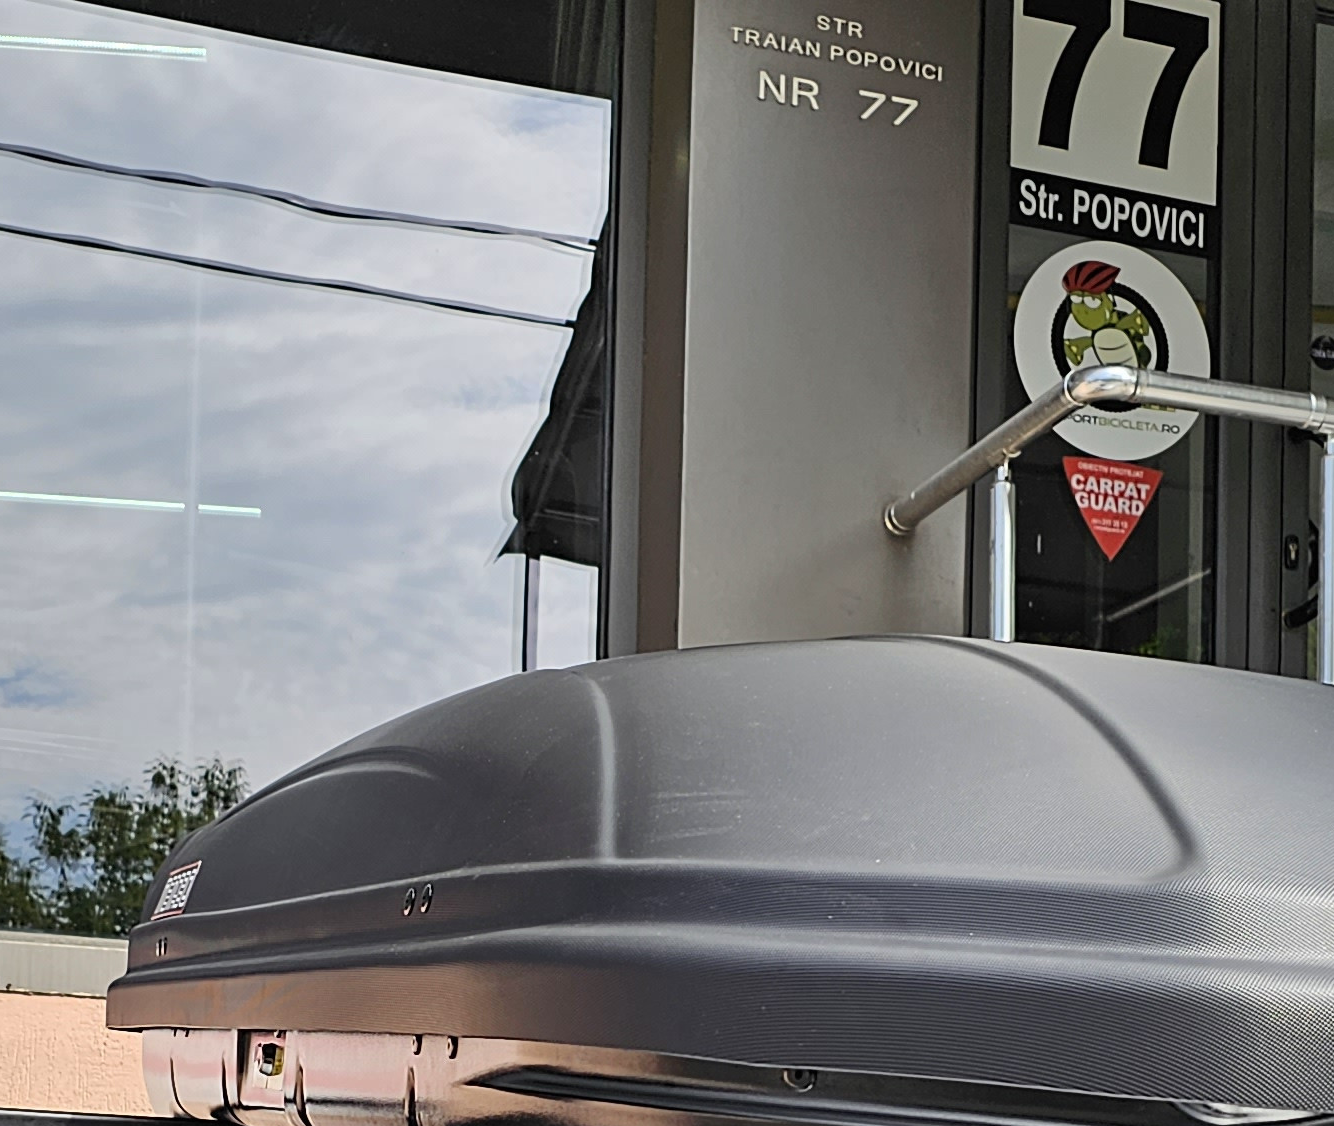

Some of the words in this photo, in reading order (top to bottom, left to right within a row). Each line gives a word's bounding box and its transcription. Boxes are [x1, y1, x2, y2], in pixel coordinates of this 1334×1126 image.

[731, 26, 821, 58] TRAIAN
[829, 44, 943, 82] POPOVICI
[816, 14, 864, 39] STR
[757, 70, 820, 110] NR
[858, 89, 919, 126] 77
[1023, 0, 1210, 170] 77
[1019, 178, 1064, 222] Str.
[1072, 188, 1205, 248] POPOVICI
[1070, 473, 1151, 500] CARPAT
[1074, 491, 1146, 517] GUARD
